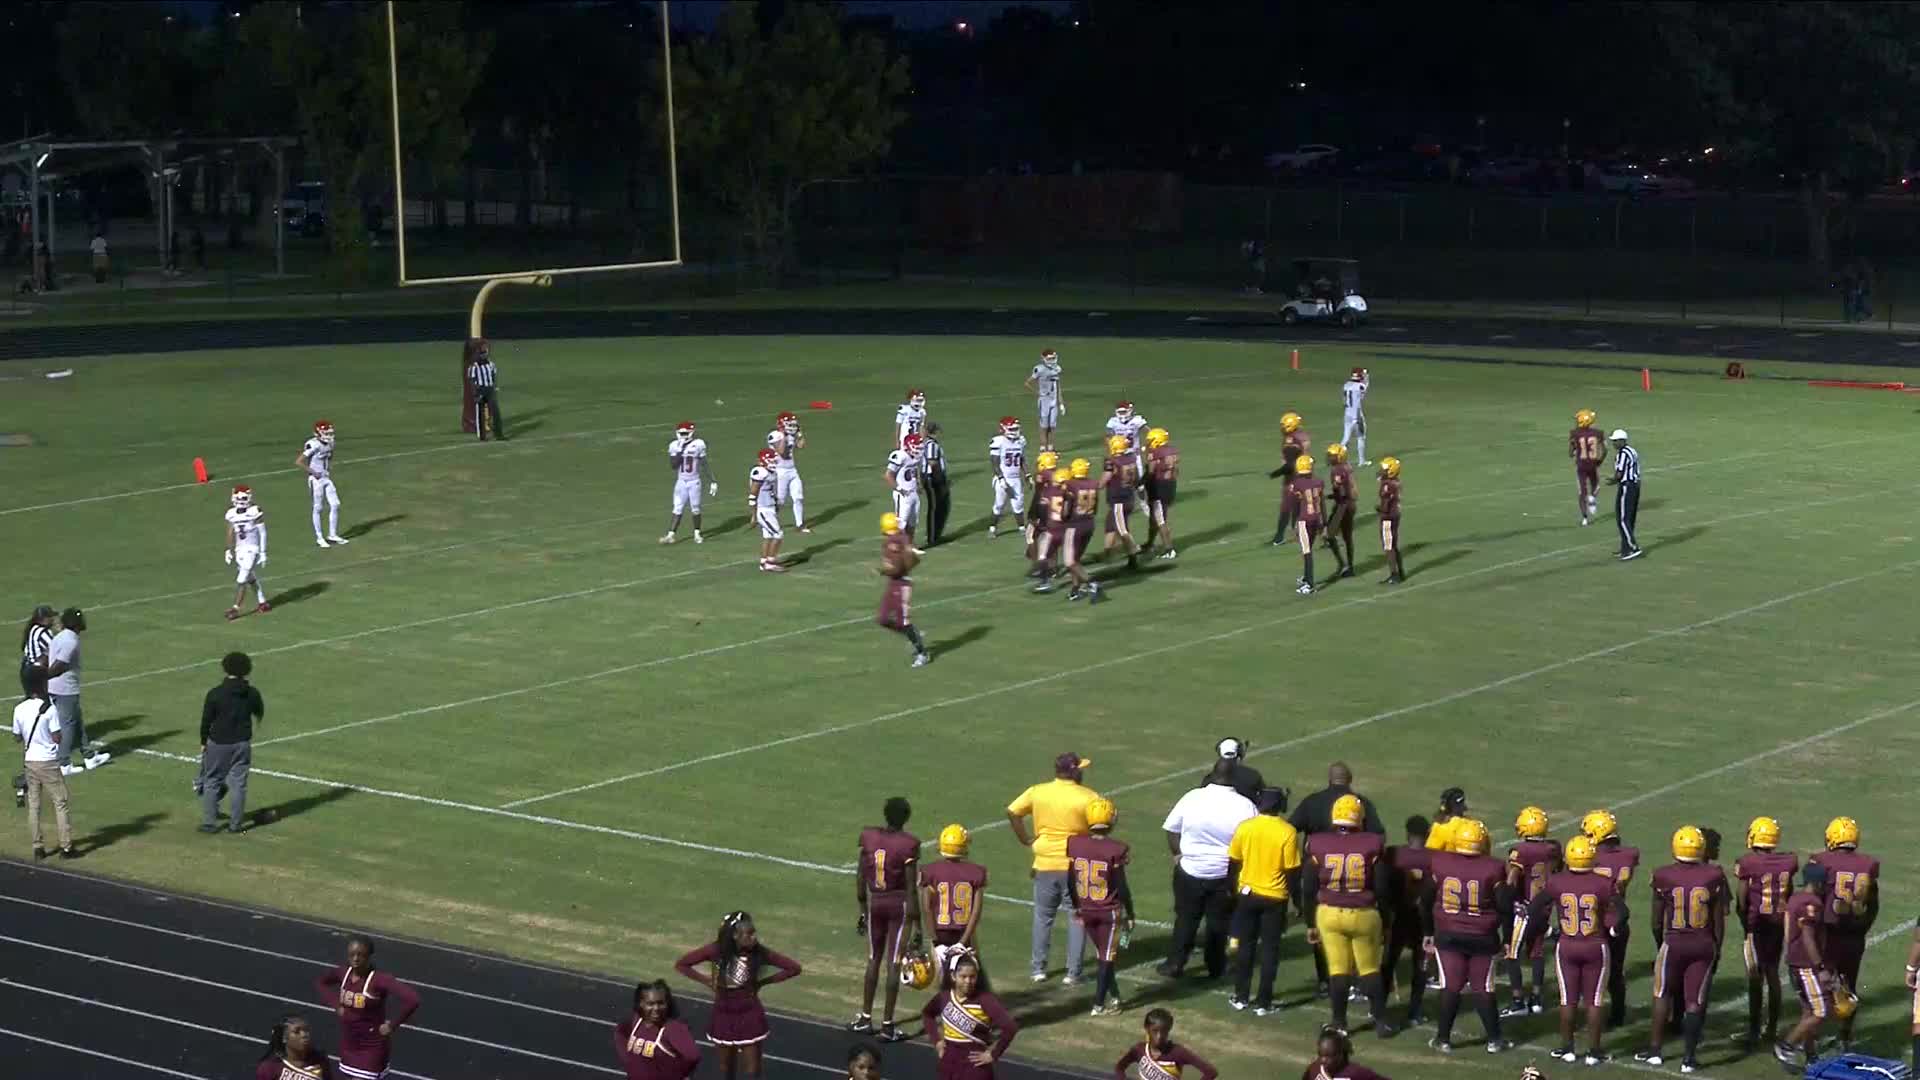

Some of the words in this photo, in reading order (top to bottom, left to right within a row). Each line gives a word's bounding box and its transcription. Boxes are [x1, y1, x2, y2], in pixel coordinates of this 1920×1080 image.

[1578, 436, 1598, 460] 13
[874, 849, 887, 889] 1
[1074, 857, 1108, 901] 35
[1325, 853, 1366, 893] 78
[937, 882, 972, 925] 19
[1442, 876, 1481, 917] 61
[1672, 887, 1710, 929] 16
[1760, 872, 1790, 914] 11
[1560, 893, 1598, 936] 33
